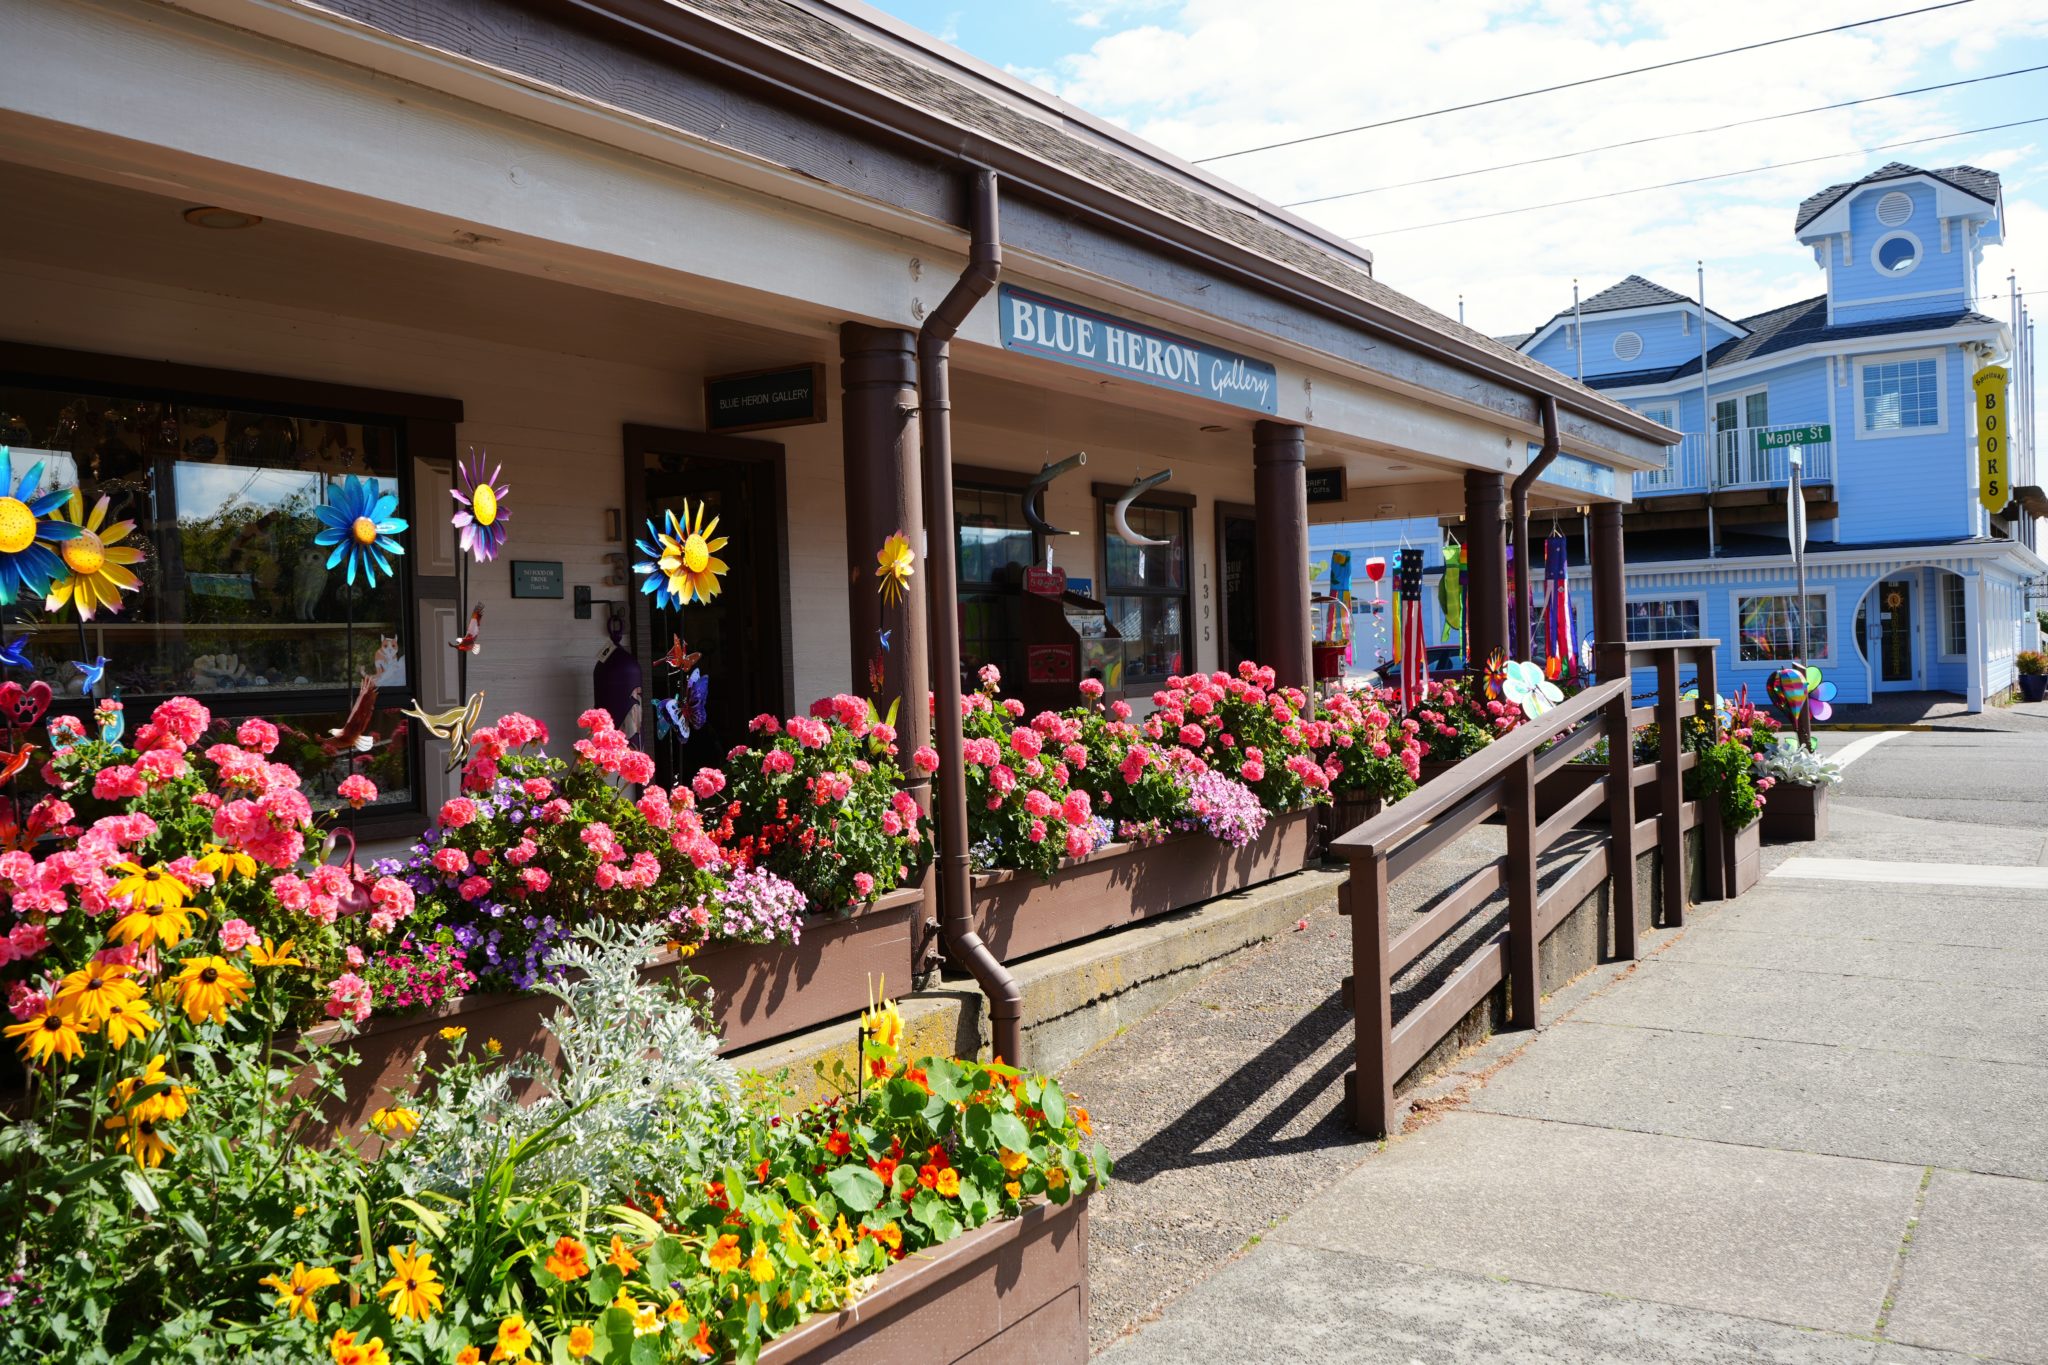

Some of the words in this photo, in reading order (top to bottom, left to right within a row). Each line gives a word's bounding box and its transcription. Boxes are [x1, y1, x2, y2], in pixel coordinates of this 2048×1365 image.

[1011, 298, 1096, 359] BLUE
[1105, 325, 1200, 386] HERON
[1210, 359, 1270, 406] Gallery
[1975, 372, 2005, 386] Spiritual
[720, 396, 740, 410] BLUE
[741, 393, 769, 407] HERON
[771, 388, 809, 403] GALLERY
[1766, 429, 1804, 446] Maple
[1809, 426, 1823, 440] St
[1984, 393, 1999, 497] BOOKS
